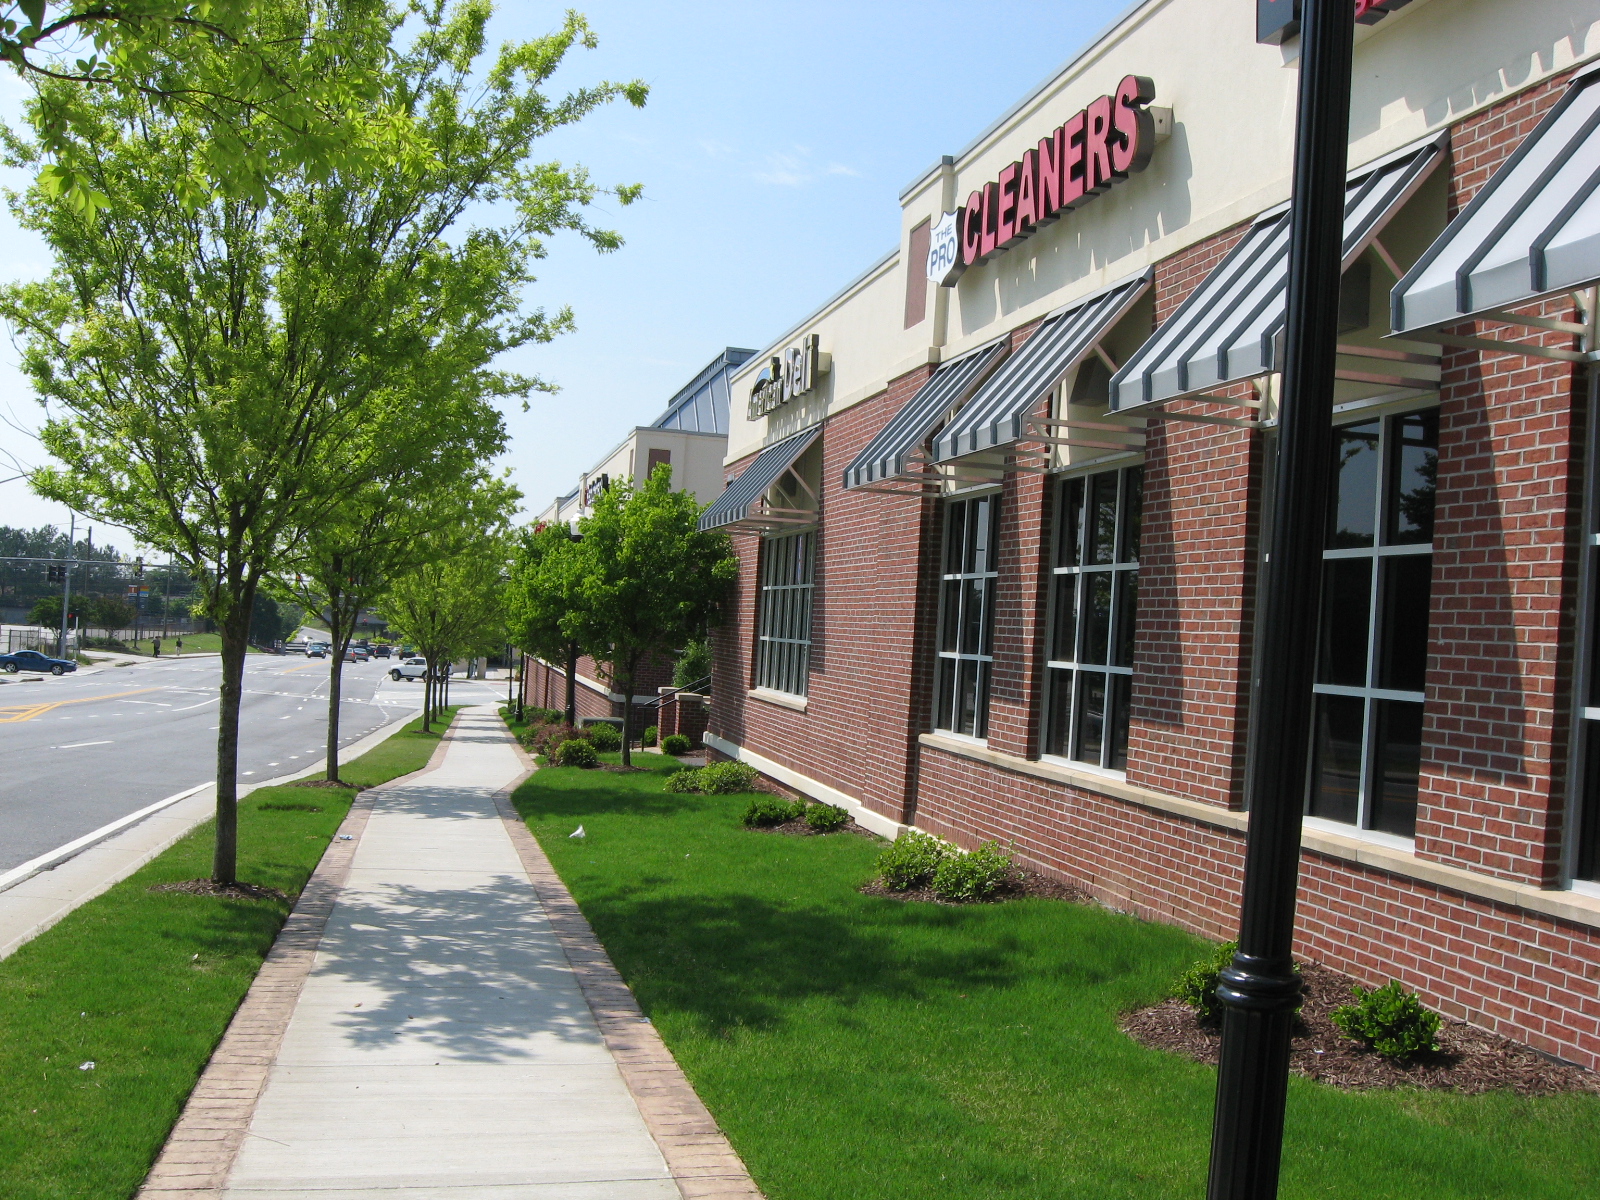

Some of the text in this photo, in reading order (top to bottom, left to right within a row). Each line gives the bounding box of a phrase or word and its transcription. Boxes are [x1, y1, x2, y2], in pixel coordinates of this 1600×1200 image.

[963, 74, 1154, 266] CLEANERS
[930, 237, 956, 276] PRO
[936, 223, 953, 243] THE
[783, 333, 817, 403] Deli
